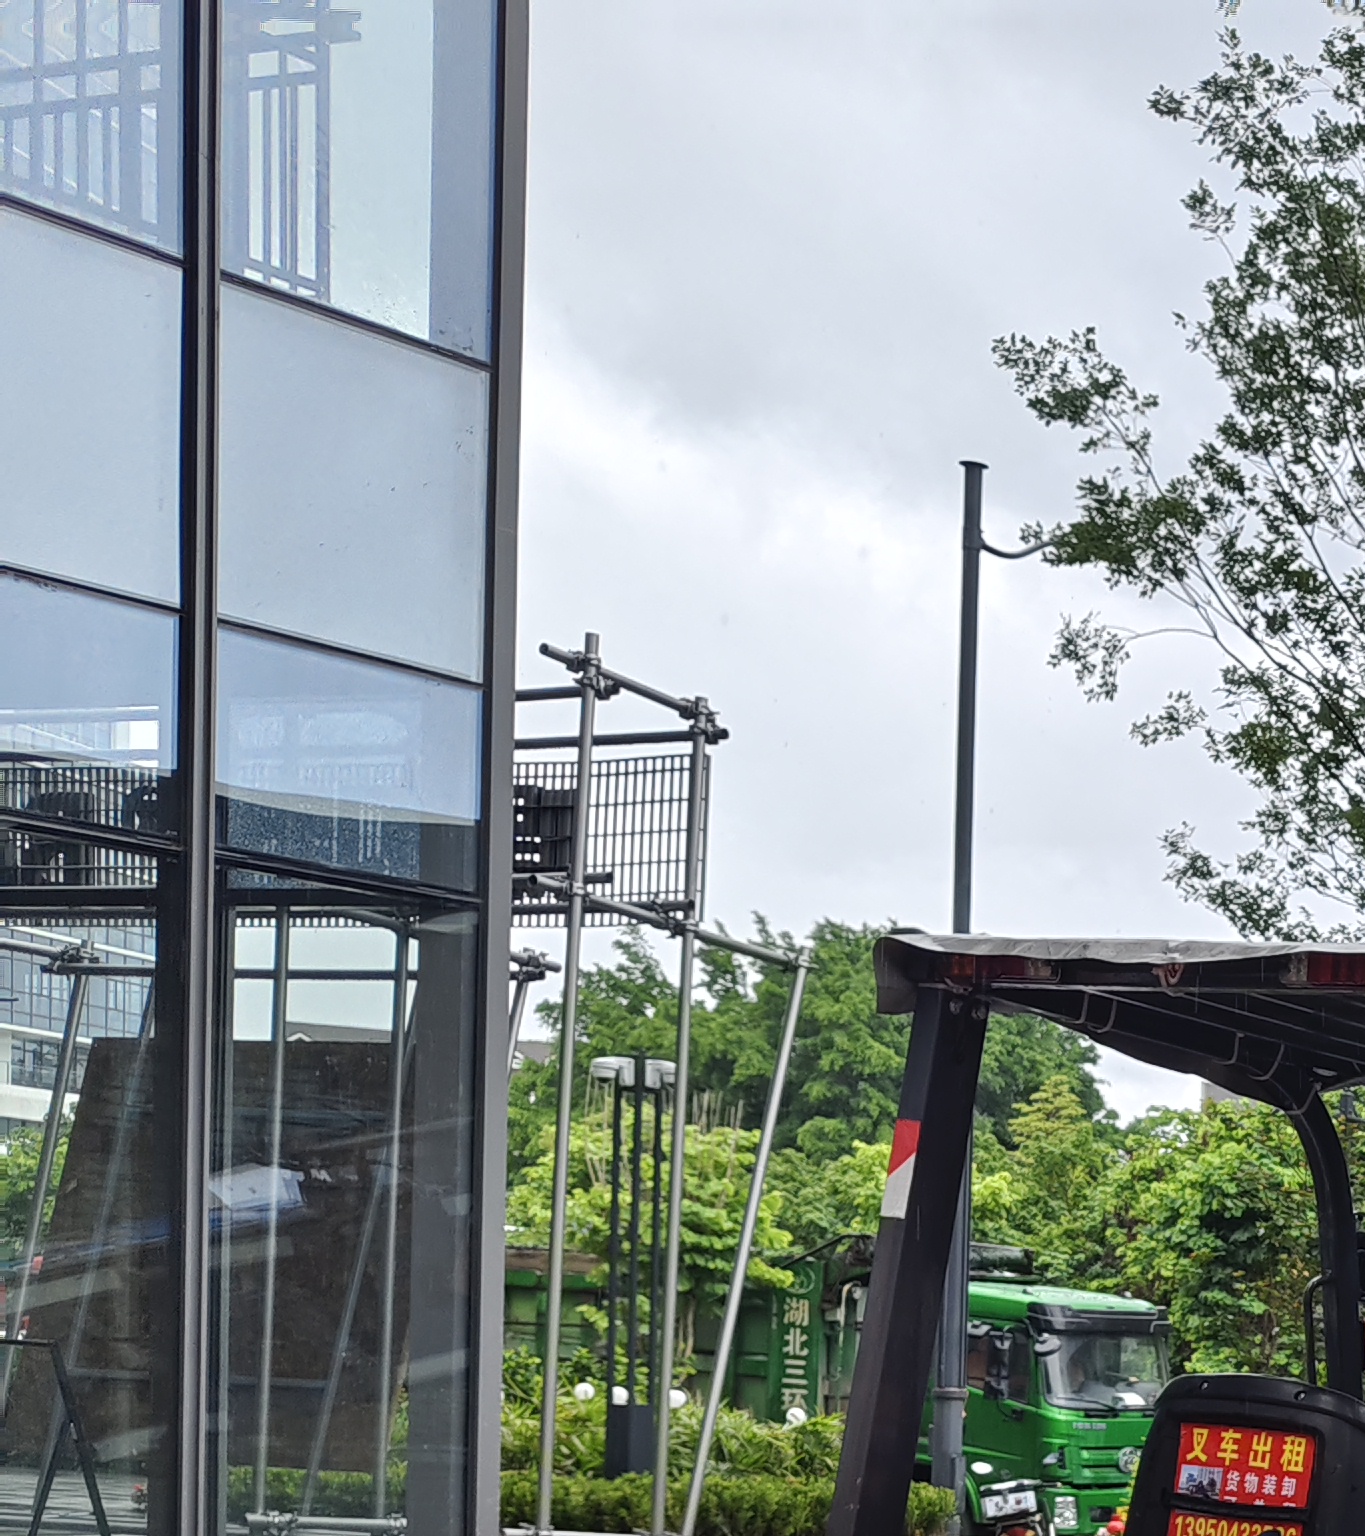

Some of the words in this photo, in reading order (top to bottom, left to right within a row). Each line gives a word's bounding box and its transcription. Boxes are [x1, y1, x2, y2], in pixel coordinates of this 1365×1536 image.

[1186, 1428, 1307, 1472] 叉车出租
[1225, 1470, 1297, 1498] 货物装卸
